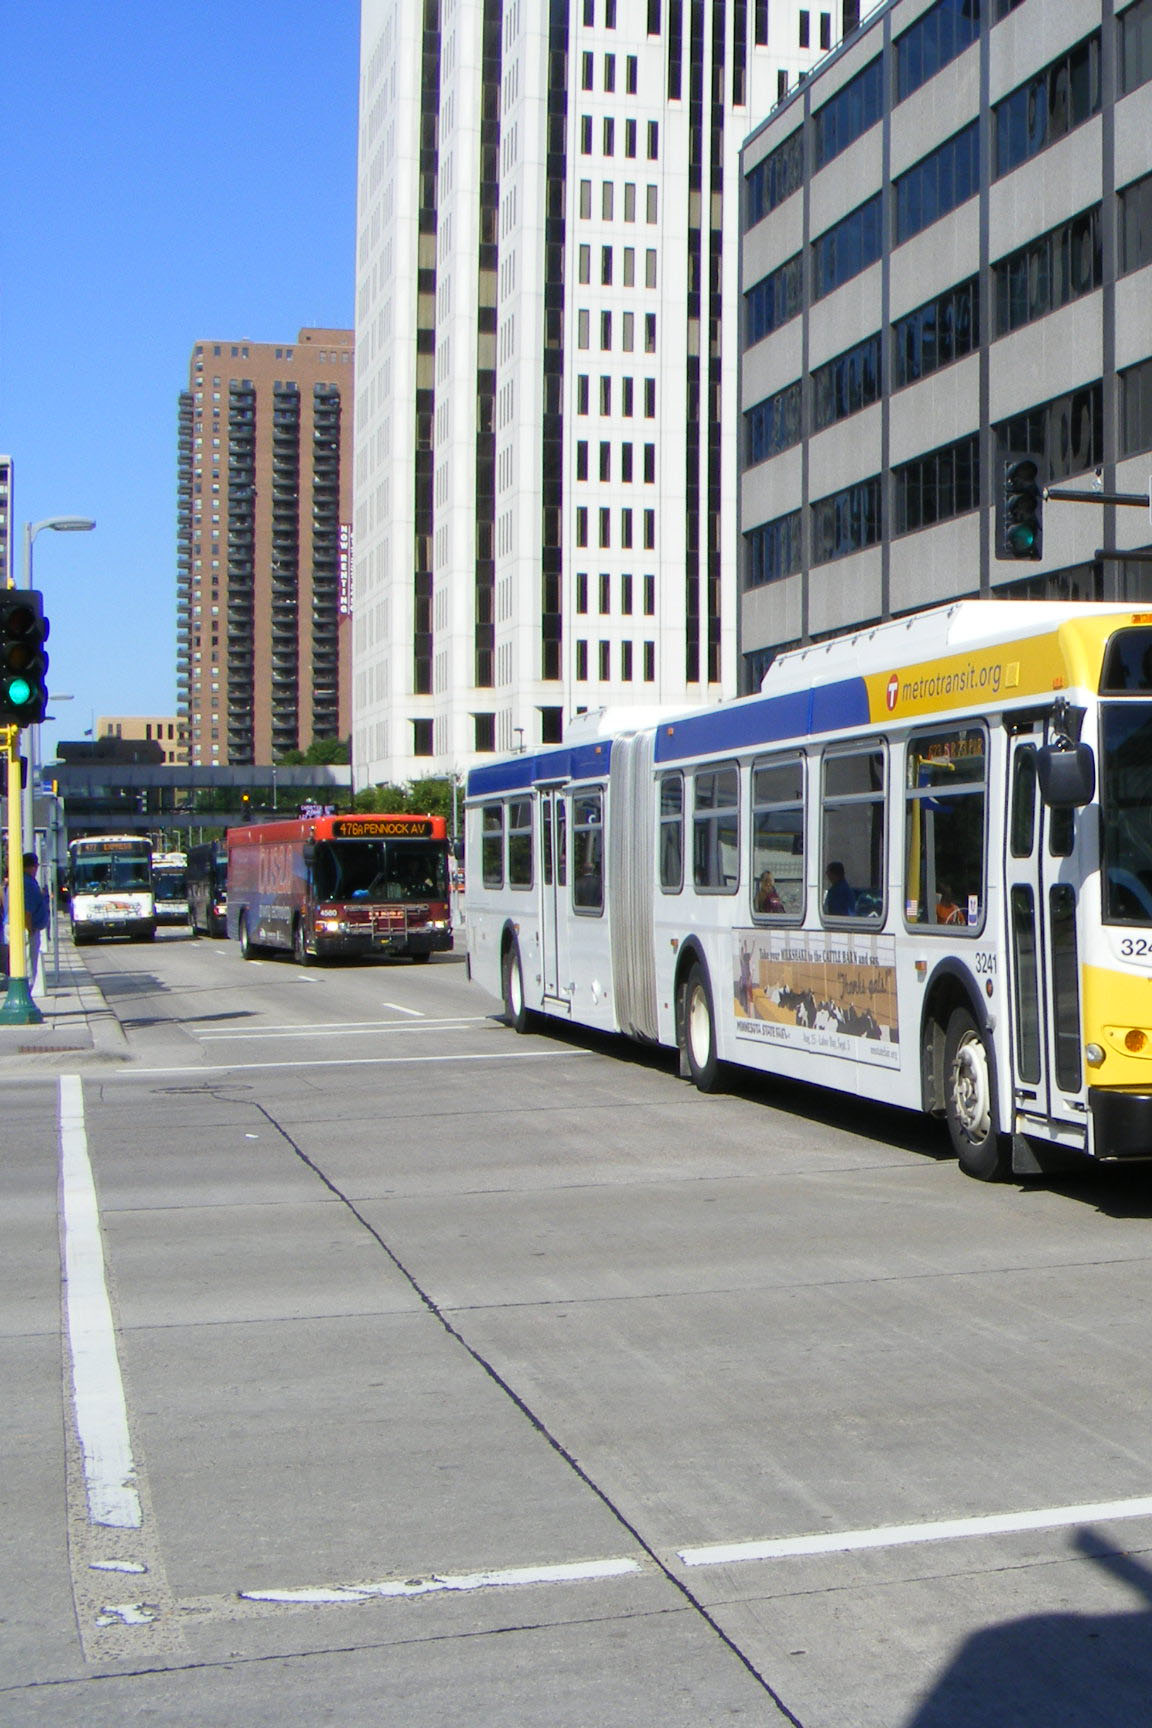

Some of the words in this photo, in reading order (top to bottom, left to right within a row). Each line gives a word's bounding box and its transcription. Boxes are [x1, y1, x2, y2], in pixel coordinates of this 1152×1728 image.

[340, 525, 348, 550] NOW
[340, 553, 348, 614] RENTING
[903, 663, 1002, 701] metrotransit.org
[364, 823, 409, 834] PENNOCK
[411, 823, 425, 833] AV
[975, 952, 997, 974] 3241
